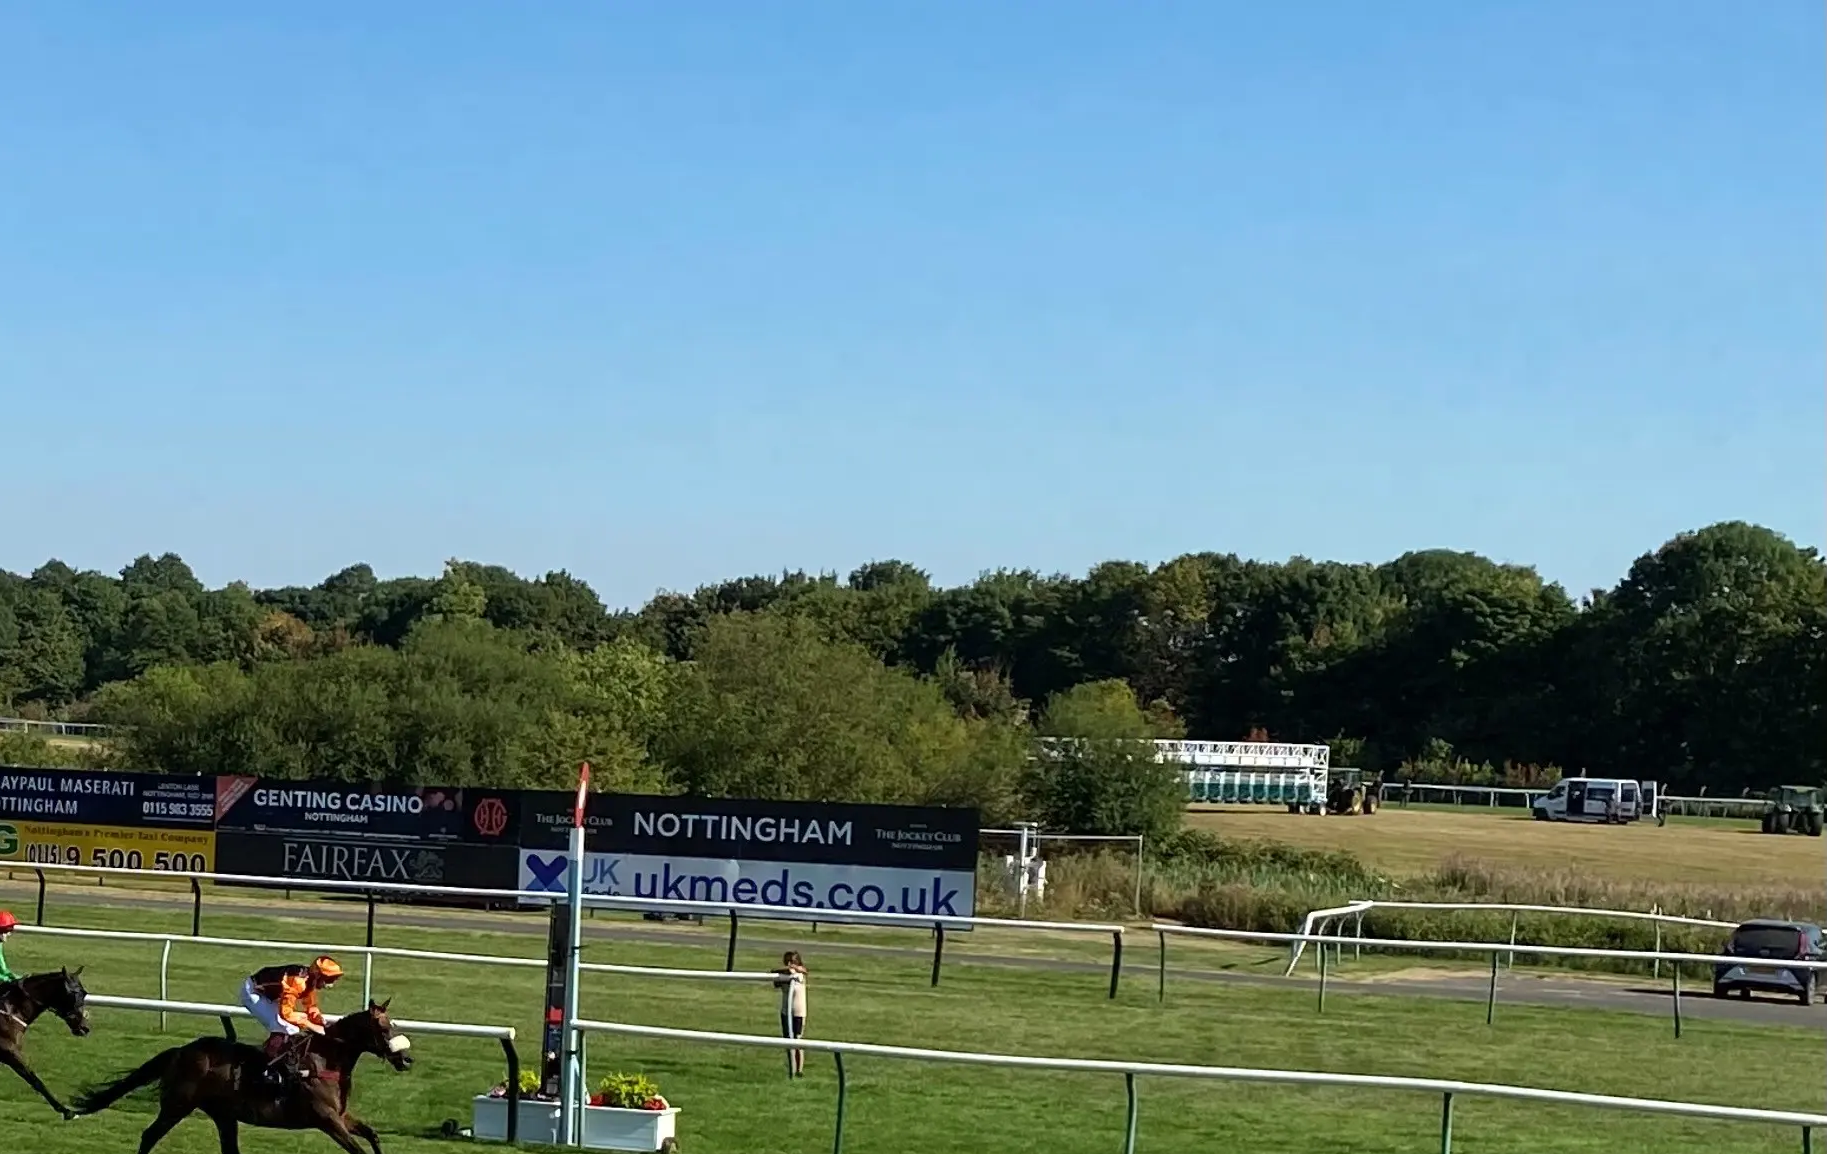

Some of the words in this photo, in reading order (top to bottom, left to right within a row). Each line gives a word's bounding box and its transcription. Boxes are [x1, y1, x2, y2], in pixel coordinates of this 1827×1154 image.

[60, 778, 135, 796] MASERATI
[142, 801, 167, 815] 0115
[254, 789, 341, 809] GENTING
[345, 793, 424, 814] CASINO
[304, 812, 369, 824] NOTTINGHAM
[536, 813, 555, 824] THE
[633, 811, 853, 846] NOTTINGHAM
[875, 828, 896, 840] THE
[898, 829, 934, 841] JOCKEY
[934, 831, 962, 842] CLUB
[161, 832, 210, 845] Company
[91, 848, 142, 869] 500
[153, 852, 207, 873] 500
[283, 843, 412, 880] FAIRFAX
[634, 862, 960, 917] ukmeds.co.uk
